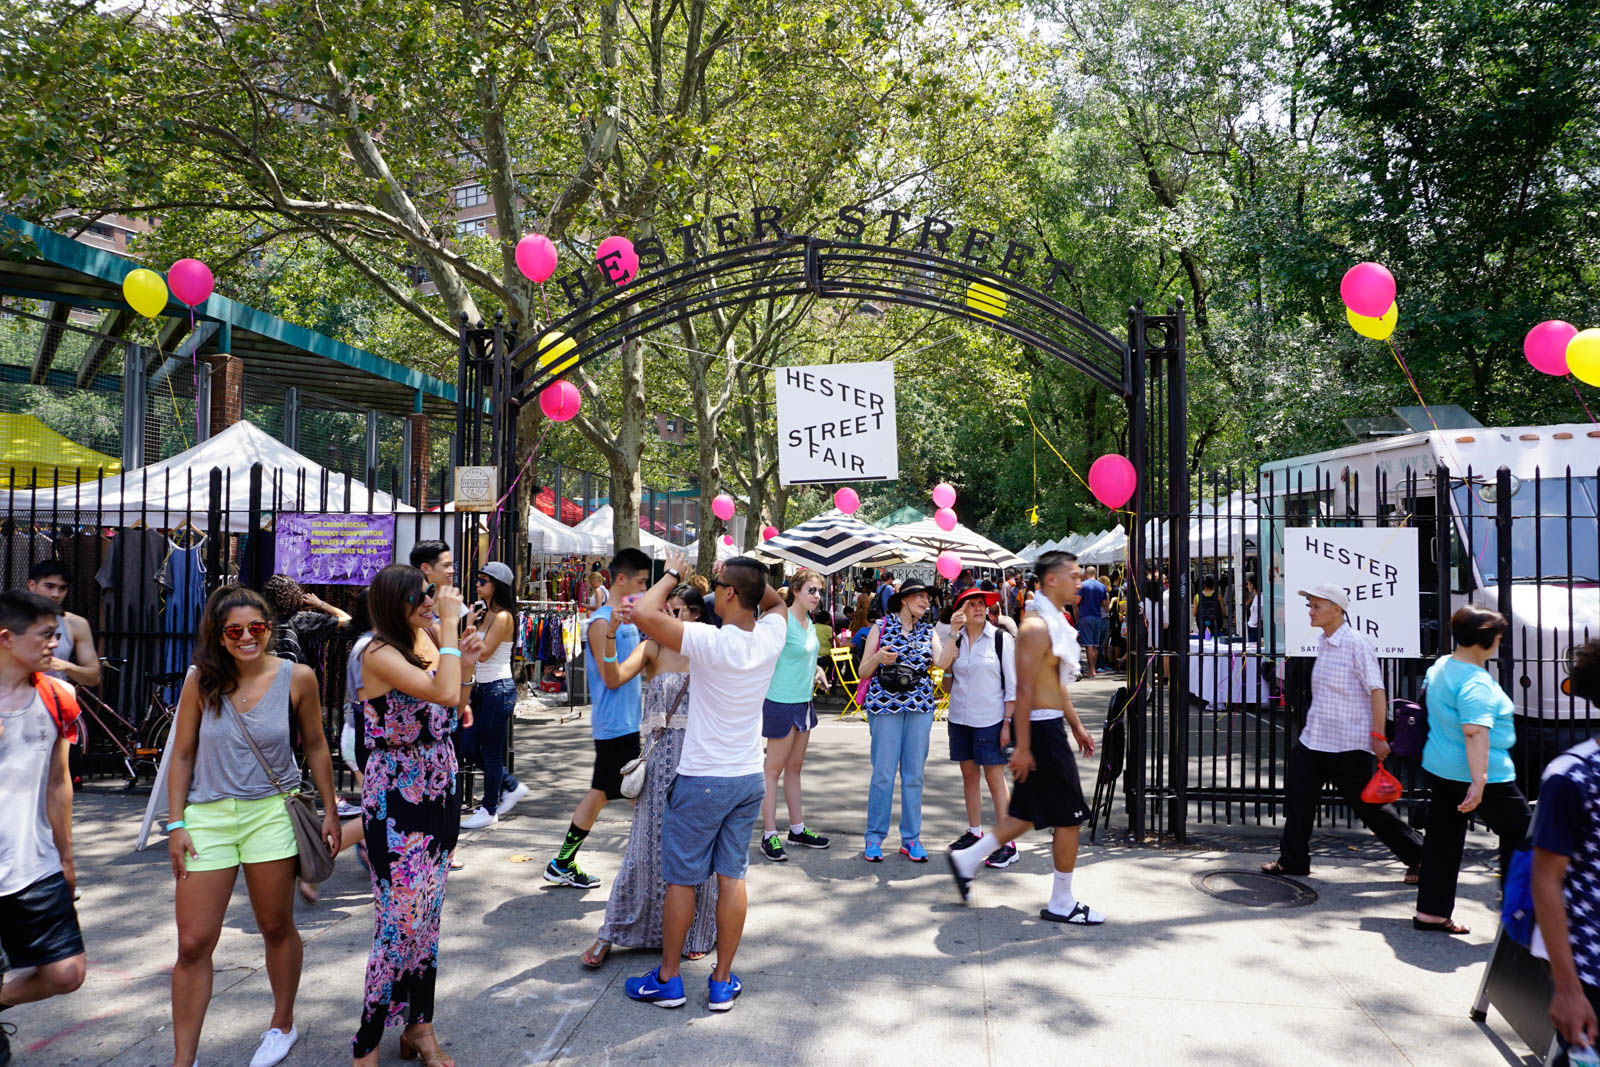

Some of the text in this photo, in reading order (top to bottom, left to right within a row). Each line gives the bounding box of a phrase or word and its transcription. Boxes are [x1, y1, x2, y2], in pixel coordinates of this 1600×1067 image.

[556, 204, 1074, 307] HESTER STREET
[786, 368, 884, 413] HESTER
[788, 413, 883, 447] STREET
[809, 442, 864, 474] FAIR
[892, 568, 934, 582] ORKSHOP
[1305, 535, 1398, 582] HESTER
[1343, 610, 1379, 638] AIR
